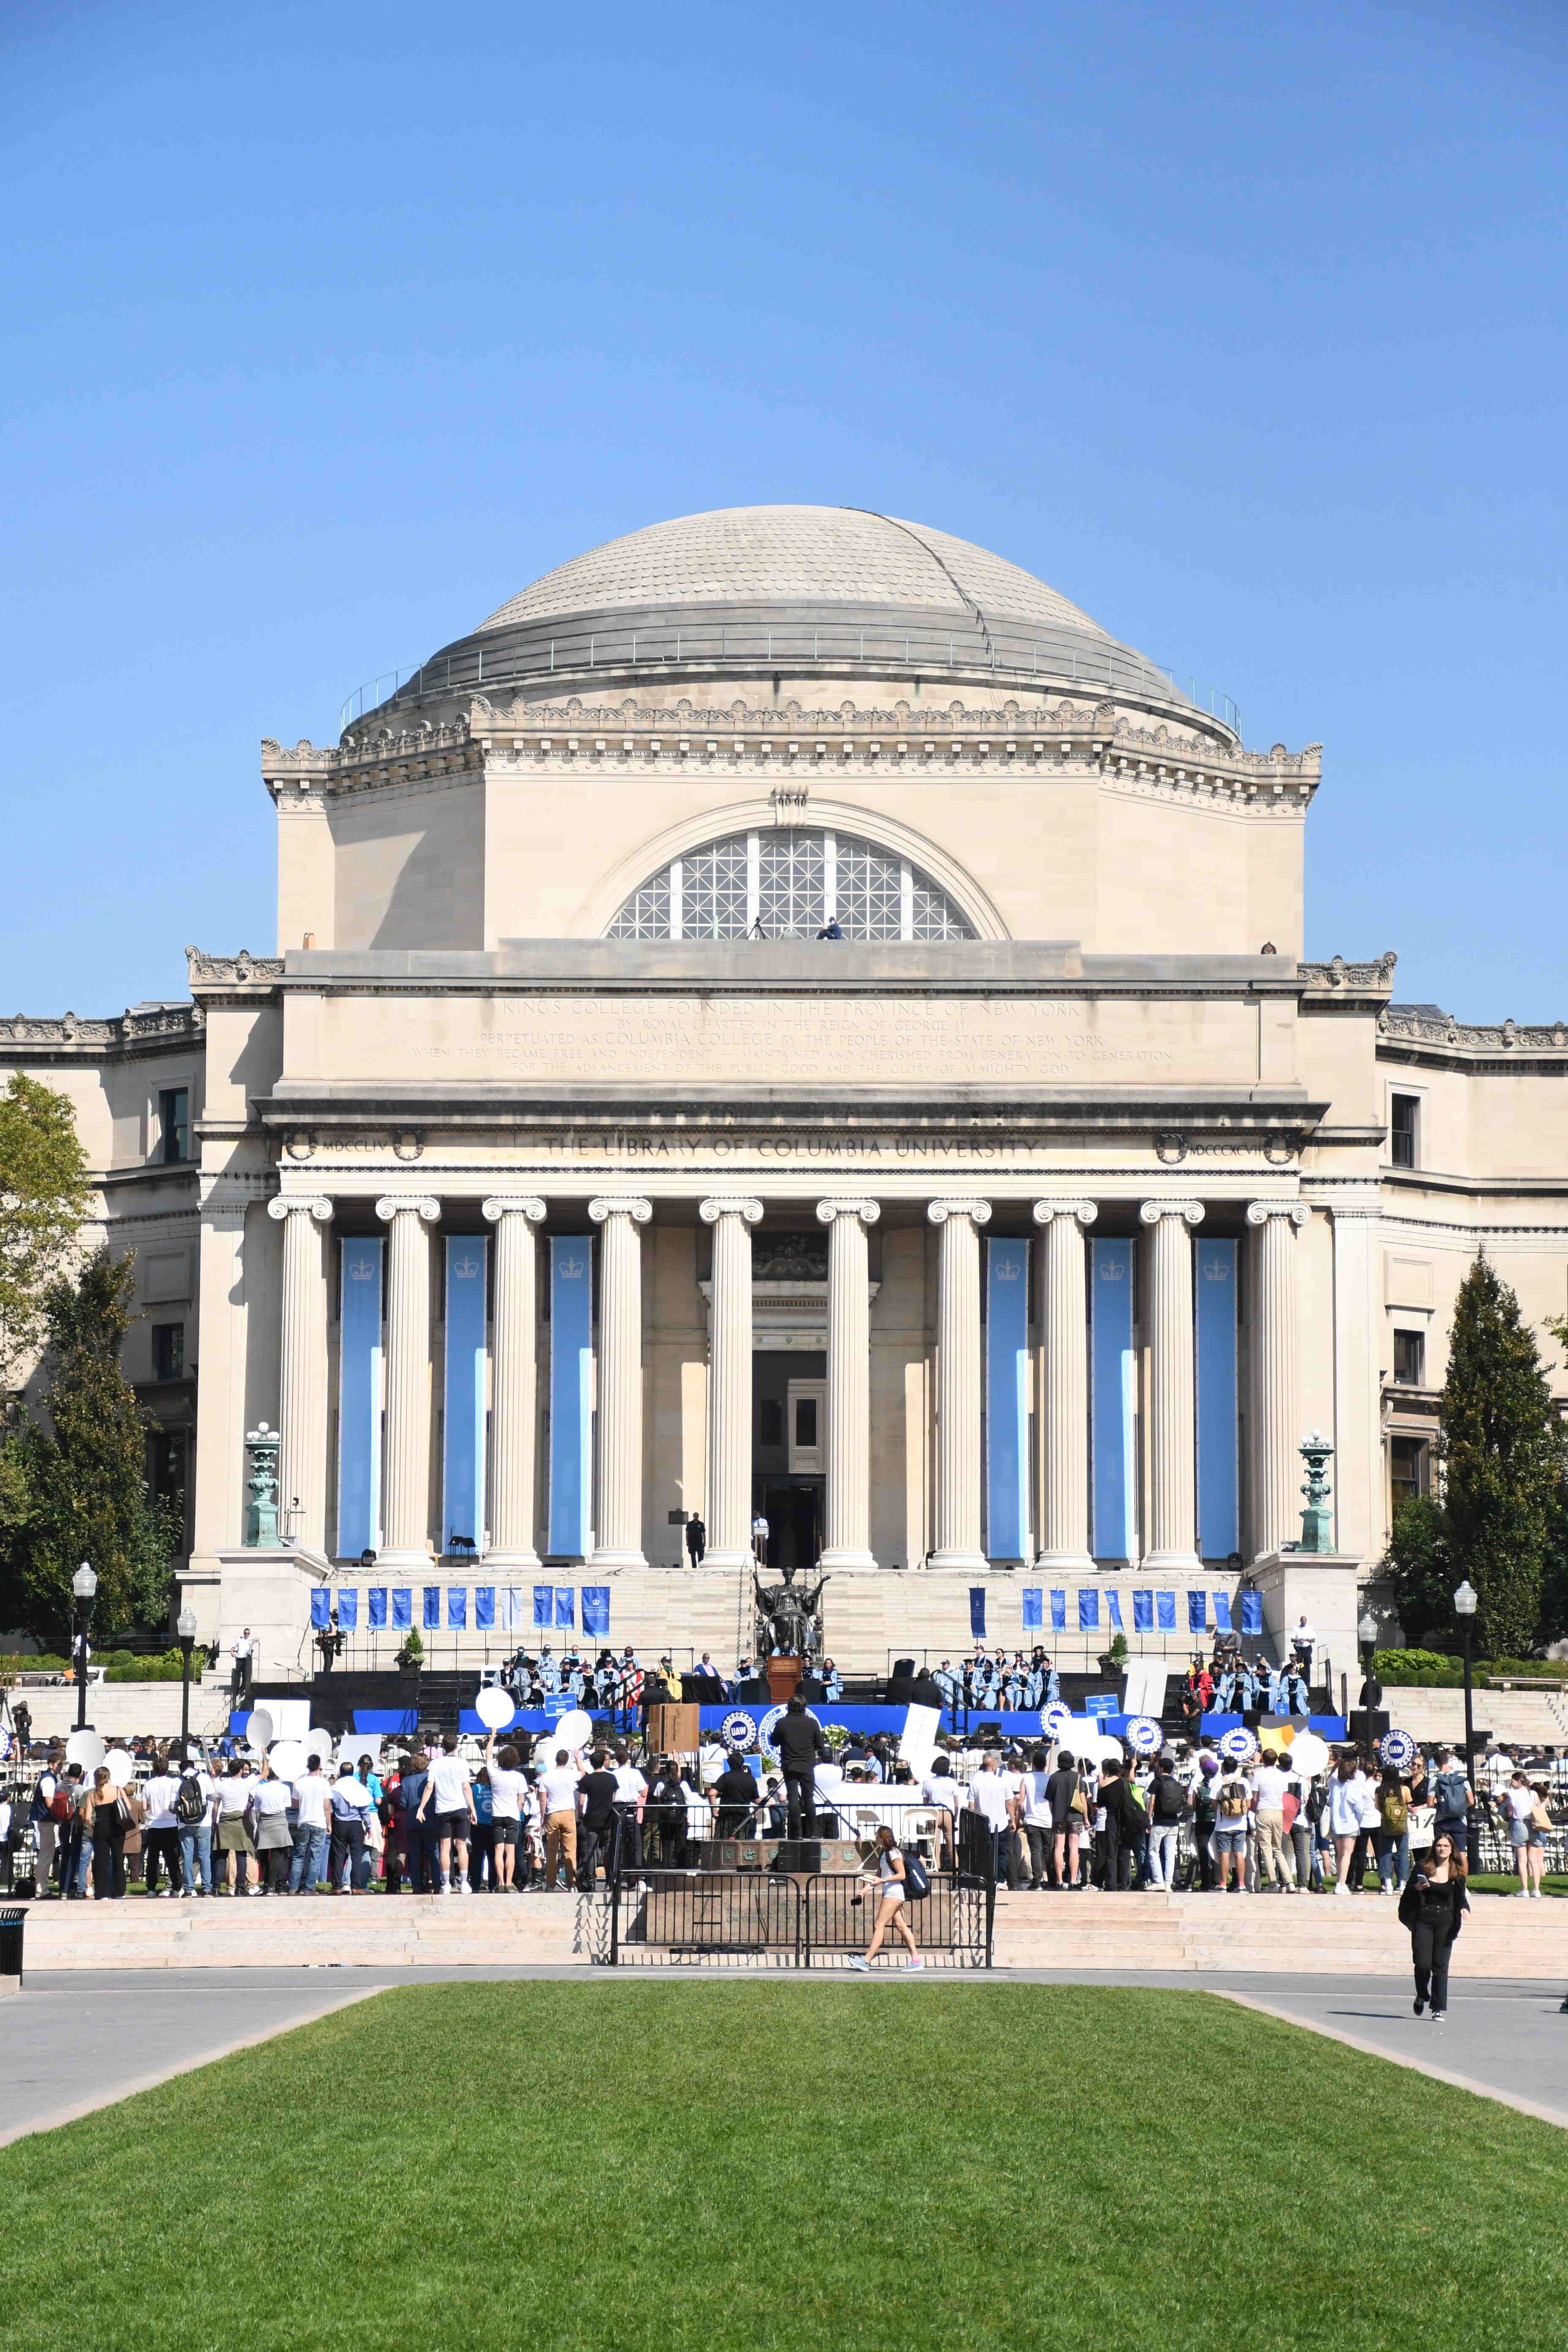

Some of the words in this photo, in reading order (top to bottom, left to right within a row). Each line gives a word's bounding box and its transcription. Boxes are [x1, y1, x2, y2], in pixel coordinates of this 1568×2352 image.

[571, 1001, 656, 1015] COLLEGE
[667, 1002, 754, 1015] FOUNDED
[767, 1002, 784, 1015] IN
[795, 1002, 832, 1015] THE
[844, 1002, 934, 1015] PROVINCE
[945, 1002, 968, 1015] OF
[980, 1002, 1018, 1016] NEW
[1030, 1002, 1080, 1016] YORK
[618, 1020, 632, 1031] BY
[642, 1020, 683, 1031] ROYAL
[693, 1020, 754, 1031] CHARTER
[763, 1020, 777, 1031] IN
[785, 1020, 811, 1031] THE
[821, 1020, 860, 1031] REIGN
[868, 1020, 887, 1031] OF
[895, 1020, 947, 1031] GEORGE
[480, 1033, 575, 1045] PERPETUATED
[583, 1034, 598, 1045] AS
[604, 1034, 691, 1045] COLUMBIA
[697, 1034, 773, 1046] COLLEGE
[781, 1034, 795, 1046] BY
[806, 1034, 835, 1046] THE
[838, 1034, 887, 1046] PEOPLE
[895, 1034, 913, 1046] OF
[919, 1034, 947, 1046] THE
[953, 1034, 994, 1046] STATE
[1000, 1034, 1018, 1047] OF
[1026, 1035, 1056, 1047] NEW
[1064, 1035, 1103, 1047] YORK
[412, 1048, 450, 1058] WHEN
[456, 1048, 490, 1058] THEY
[497, 1048, 546, 1058] BECAME
[553, 1048, 582, 1059] FREE
[591, 1049, 617, 1059] AND
[626, 1049, 713, 1059] INDEPENDENT
[742, 1049, 819, 1059] MAINTAINED
[828, 1050, 853, 1060] AND
[861, 1050, 931, 1060] CHERISHED
[939, 1051, 975, 1060] FROM
[982, 1051, 1062, 1061] GENERATION
[1068, 1051, 1085, 1061] TO
[1092, 1051, 1173, 1061] GENERATION
[512, 1062, 535, 1073] FOR
[543, 1062, 567, 1073] THE
[574, 1063, 667, 1073] ADVANCEMENT
[675, 1063, 691, 1073] OF
[699, 1063, 723, 1073] THE
[730, 1063, 772, 1073] PUBLIC
[780, 1063, 818, 1074] GOOD
[827, 1064, 851, 1074] AND
[859, 1064, 882, 1074] THE
[891, 1064, 929, 1074] GLORY
[939, 1064, 957, 1074] OF
[965, 1064, 1031, 1075] ALMIGHTY
[1040, 1064, 1069, 1075] GOD
[322, 1141, 387, 1153] MDCCLIV
[544, 1138, 589, 1156] THE
[604, 1138, 703, 1156] LIBRARY
[713, 1139, 744, 1156] OF
[757, 1139, 882, 1157] COLUMBIA
[895, 1140, 1038, 1158] UNIVERSITY
[731, 1726, 746, 1736] UAW
[1138, 1730, 1153, 1741] UAW
[1229, 1740, 1247, 1748] UAW
[1389, 1745, 1403, 1754] UAW
